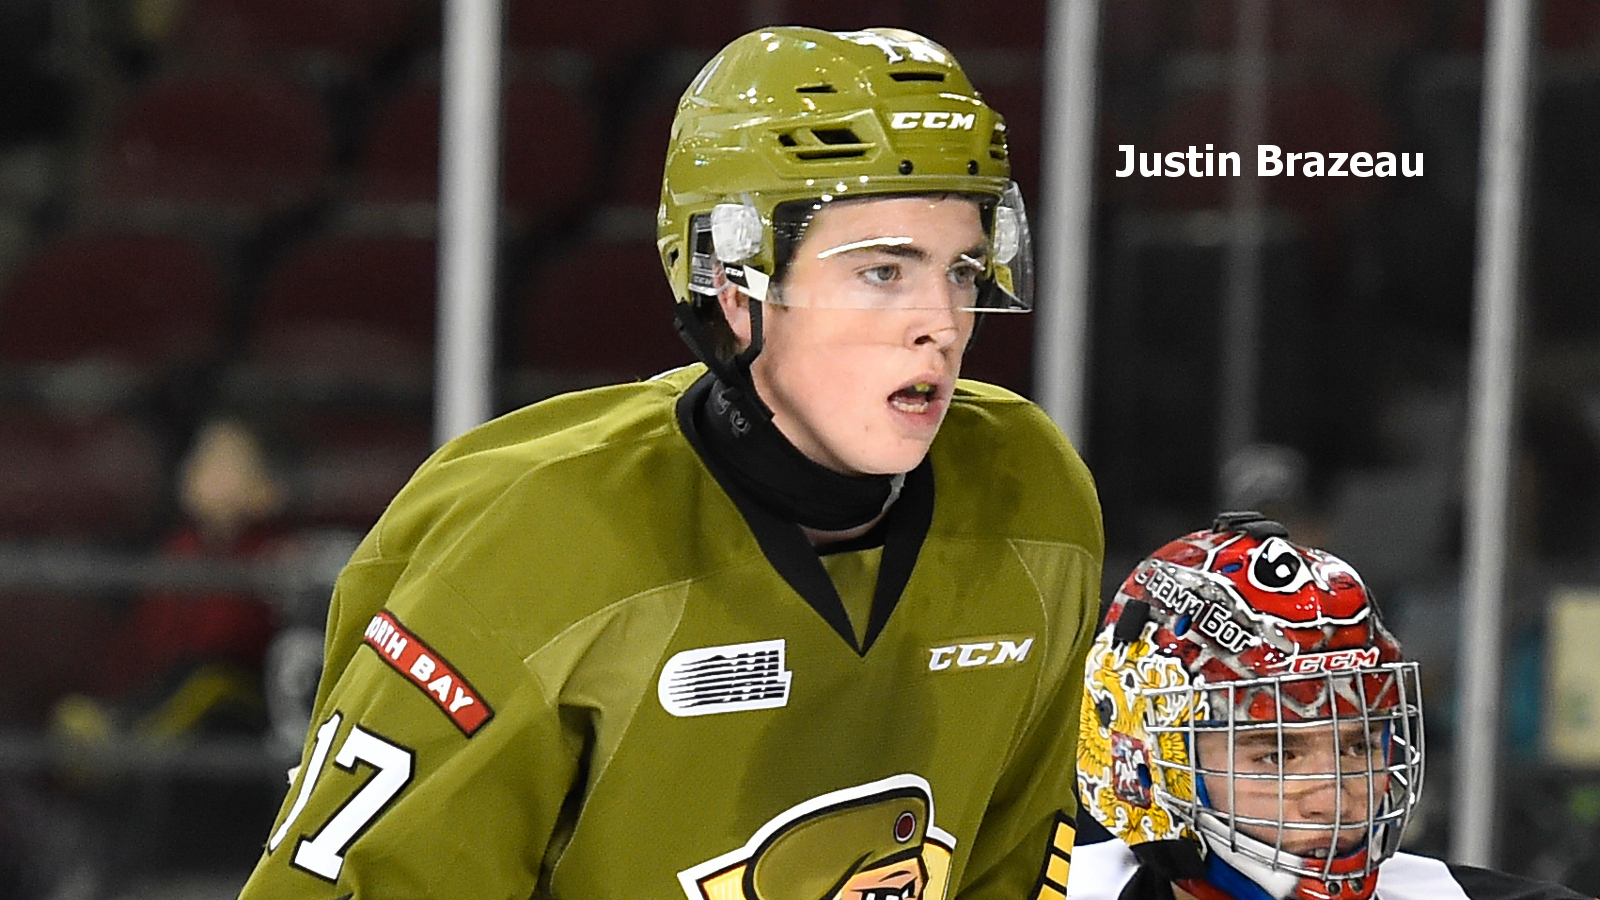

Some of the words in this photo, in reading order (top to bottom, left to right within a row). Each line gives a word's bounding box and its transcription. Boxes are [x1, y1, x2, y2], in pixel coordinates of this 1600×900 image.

[891, 112, 975, 130] CCM
[928, 638, 1034, 671] CCM
[1290, 647, 1380, 674] CCM
[409, 653, 474, 713] BAY
[269, 713, 412, 880] 17
